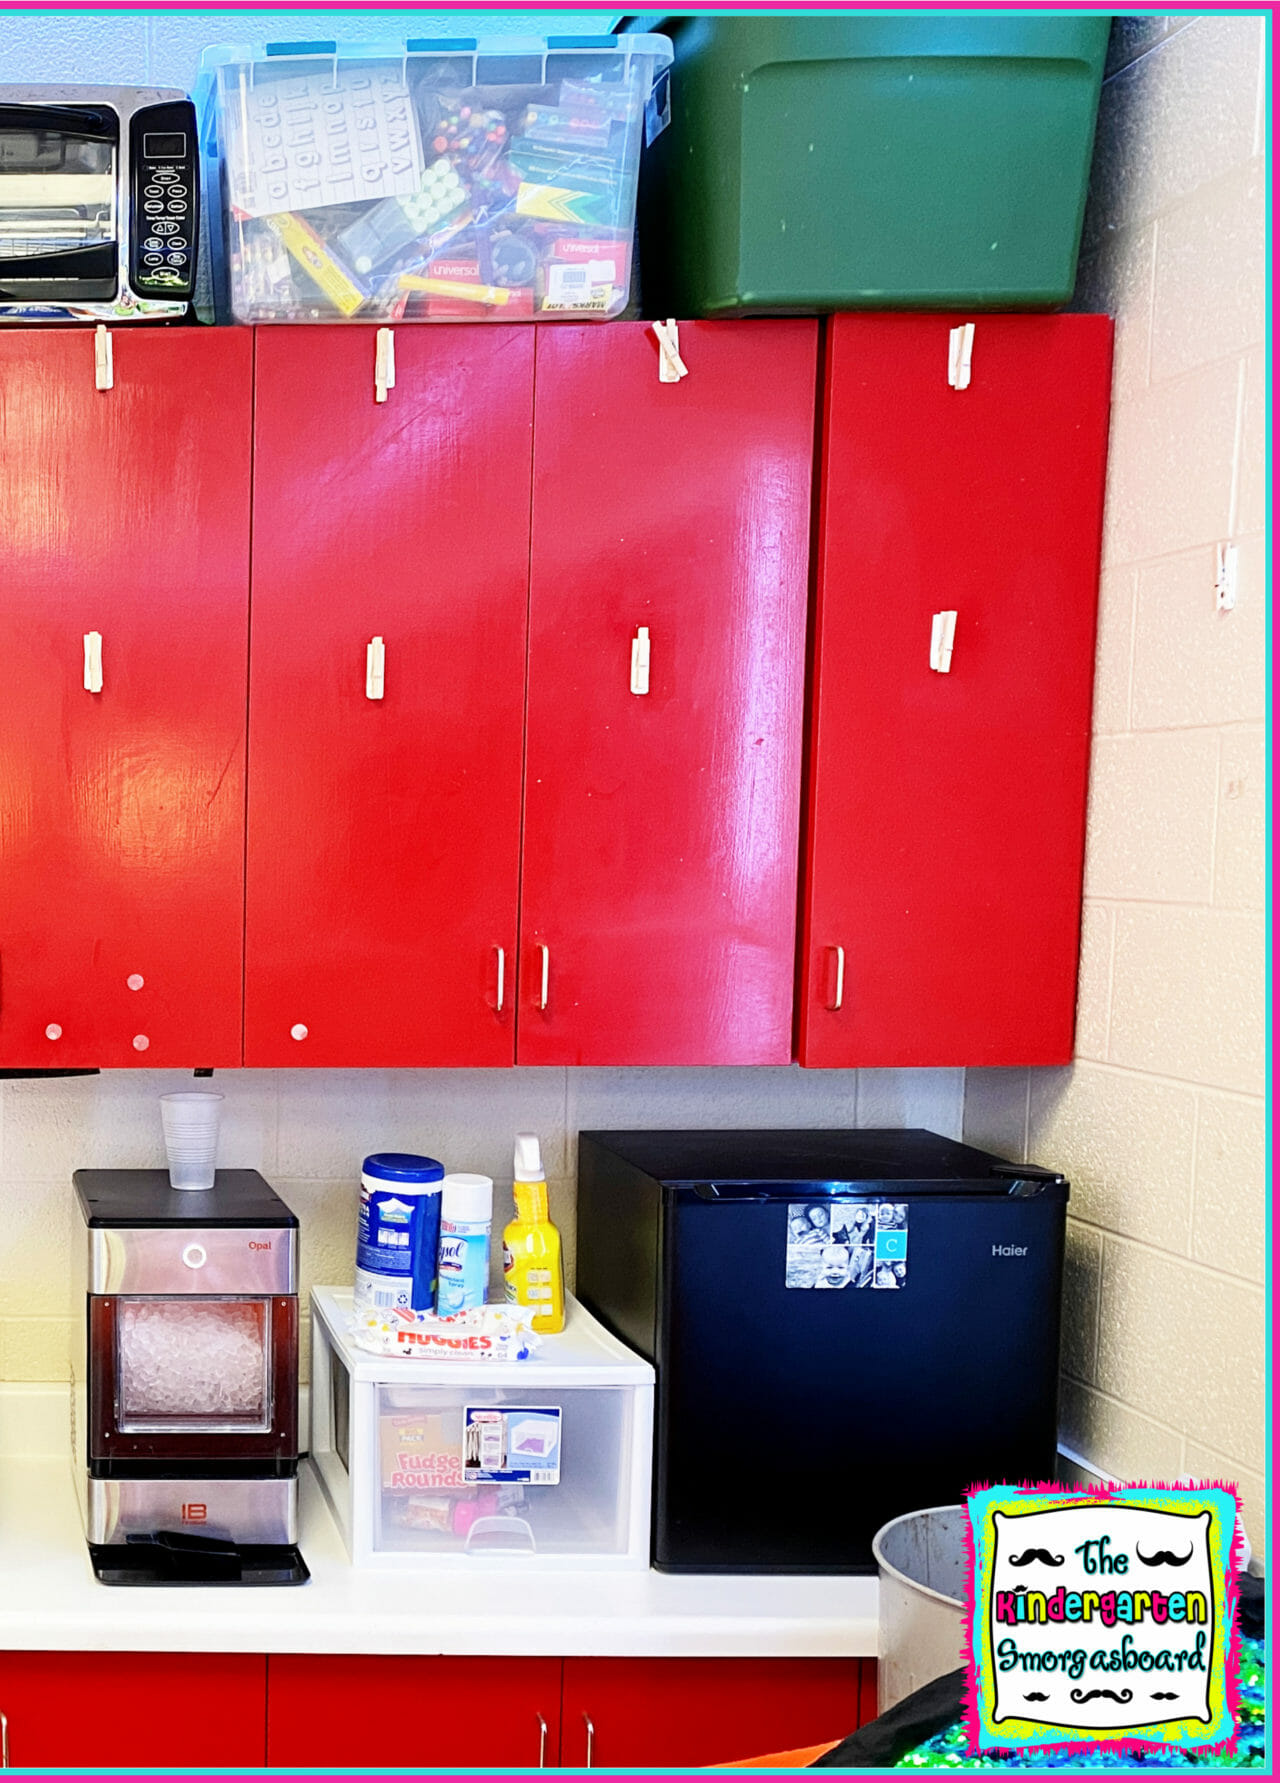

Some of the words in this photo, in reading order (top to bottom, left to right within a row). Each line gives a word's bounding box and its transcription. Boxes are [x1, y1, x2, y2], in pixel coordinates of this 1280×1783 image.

[433, 264, 480, 276] universal
[248, 1240, 272, 1253] Opal
[886, 1239, 898, 1252] C
[991, 1244, 1028, 1257] Haier
[439, 1242, 463, 1263] ysol
[398, 1453, 461, 1472] Fudge
[392, 1470, 466, 1488] Rounds
